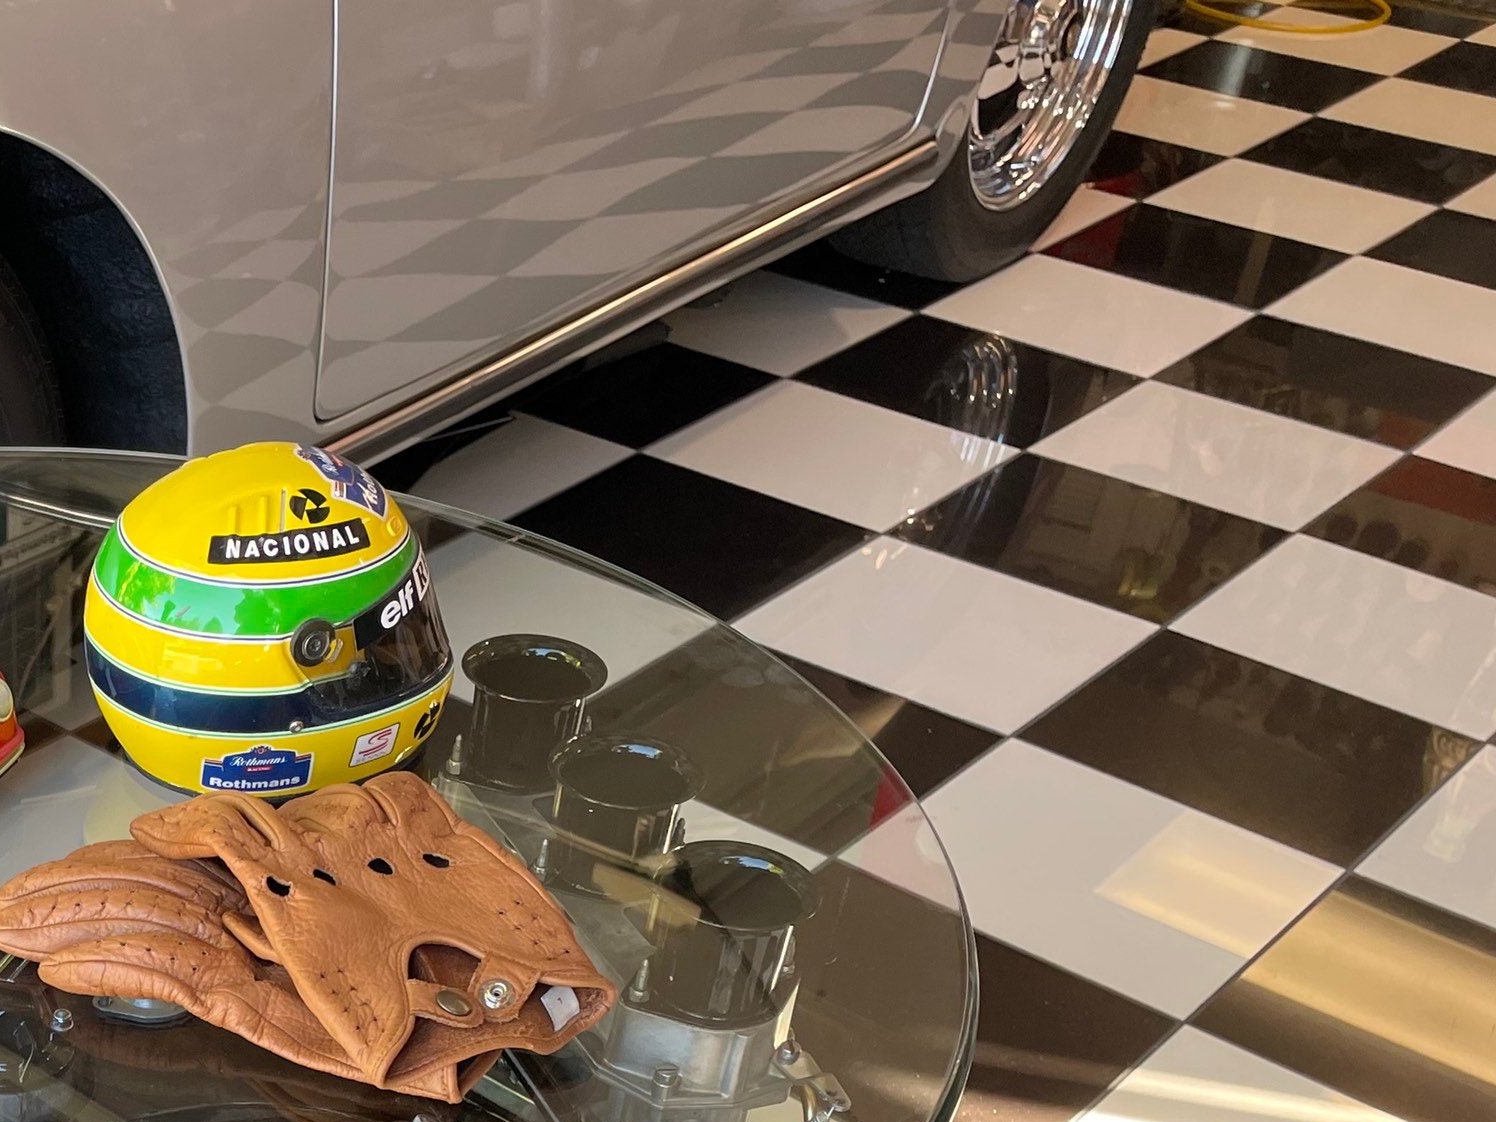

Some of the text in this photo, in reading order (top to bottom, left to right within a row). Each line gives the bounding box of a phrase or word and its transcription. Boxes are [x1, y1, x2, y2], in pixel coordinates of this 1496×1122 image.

[225, 525, 360, 559] NACIONAL
[380, 579, 414, 629] elf
[230, 756, 288, 767] Rothmans
[209, 776, 301, 789] Rothmans
